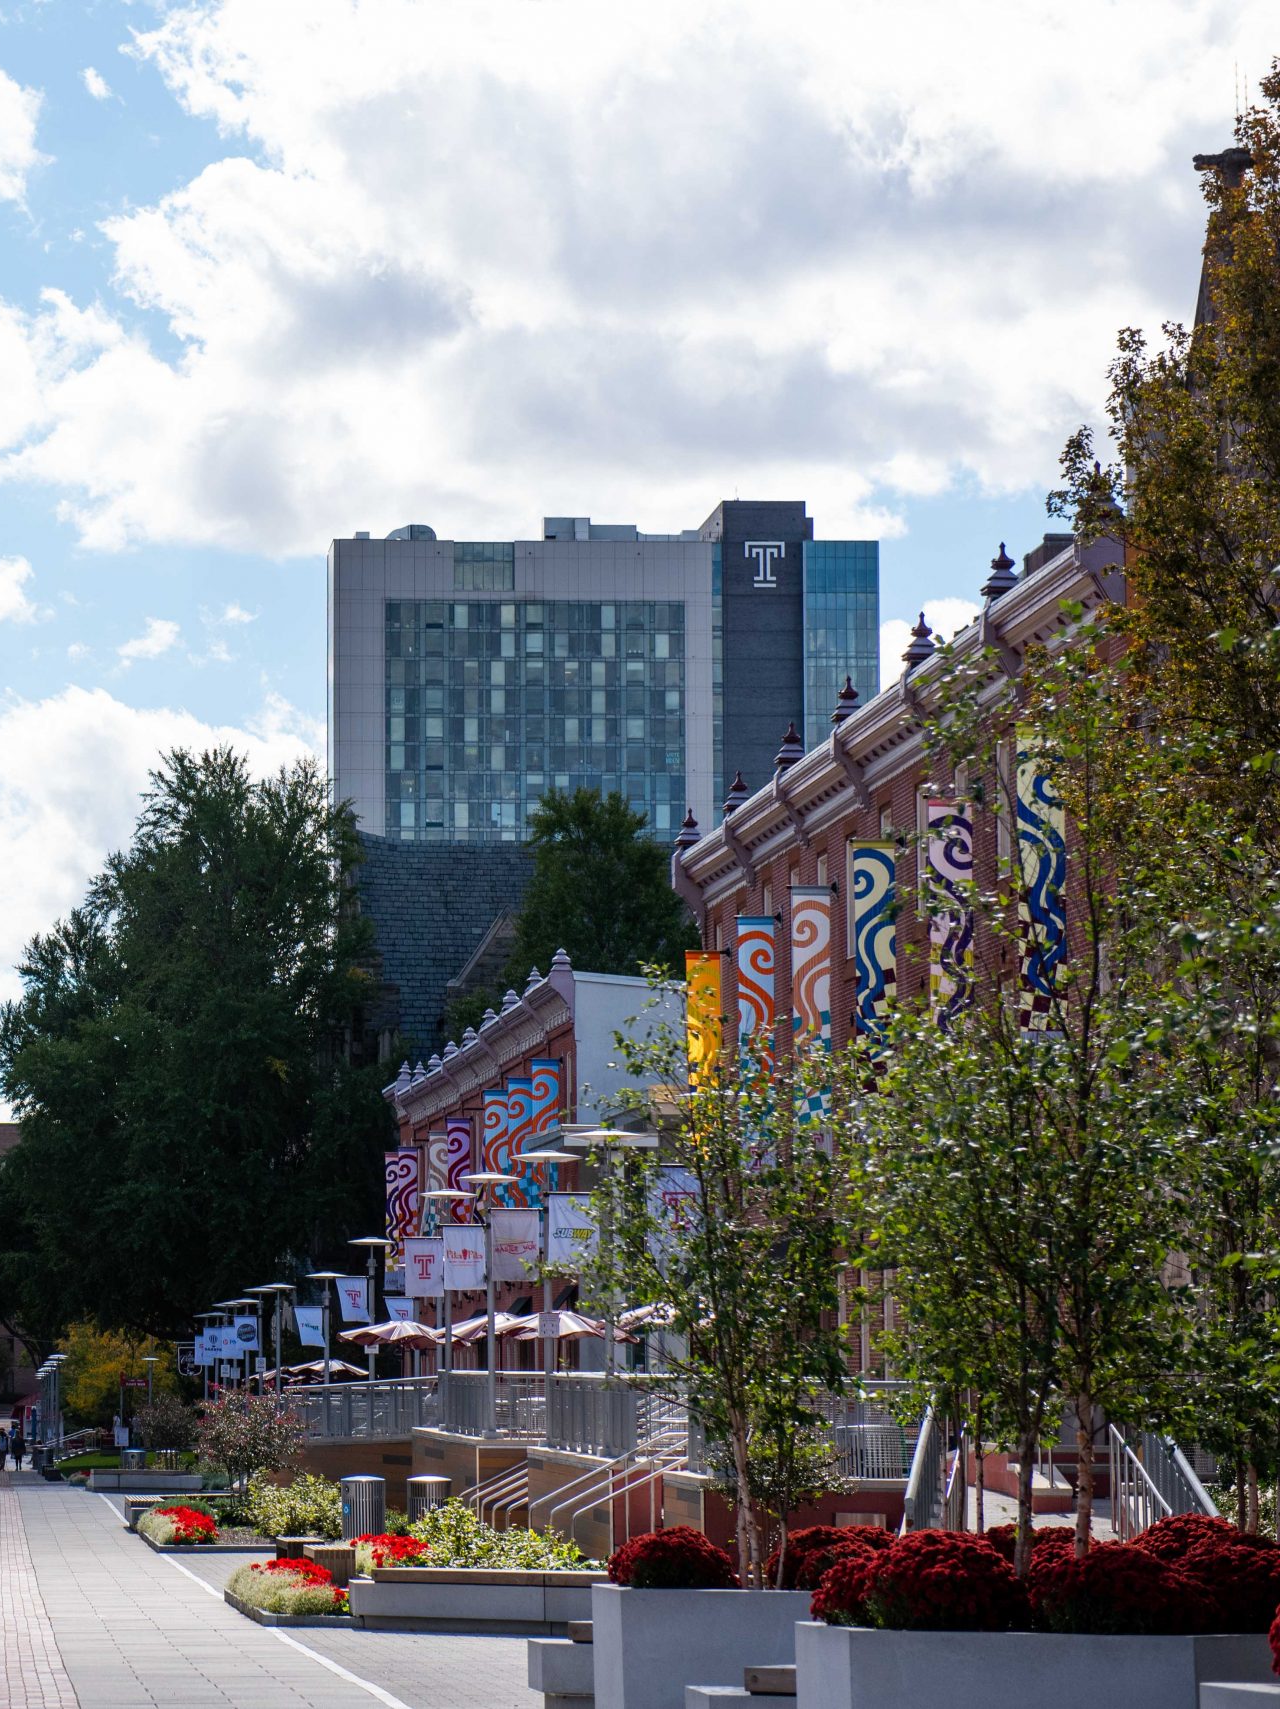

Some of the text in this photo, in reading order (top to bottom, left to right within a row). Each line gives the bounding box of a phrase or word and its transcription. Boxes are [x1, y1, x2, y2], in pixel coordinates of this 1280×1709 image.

[744, 541, 786, 588] T
[662, 1191, 696, 1232] T
[553, 1227, 596, 1240] SUBWAY
[413, 1254, 435, 1280] T
[344, 1289, 361, 1309] T
